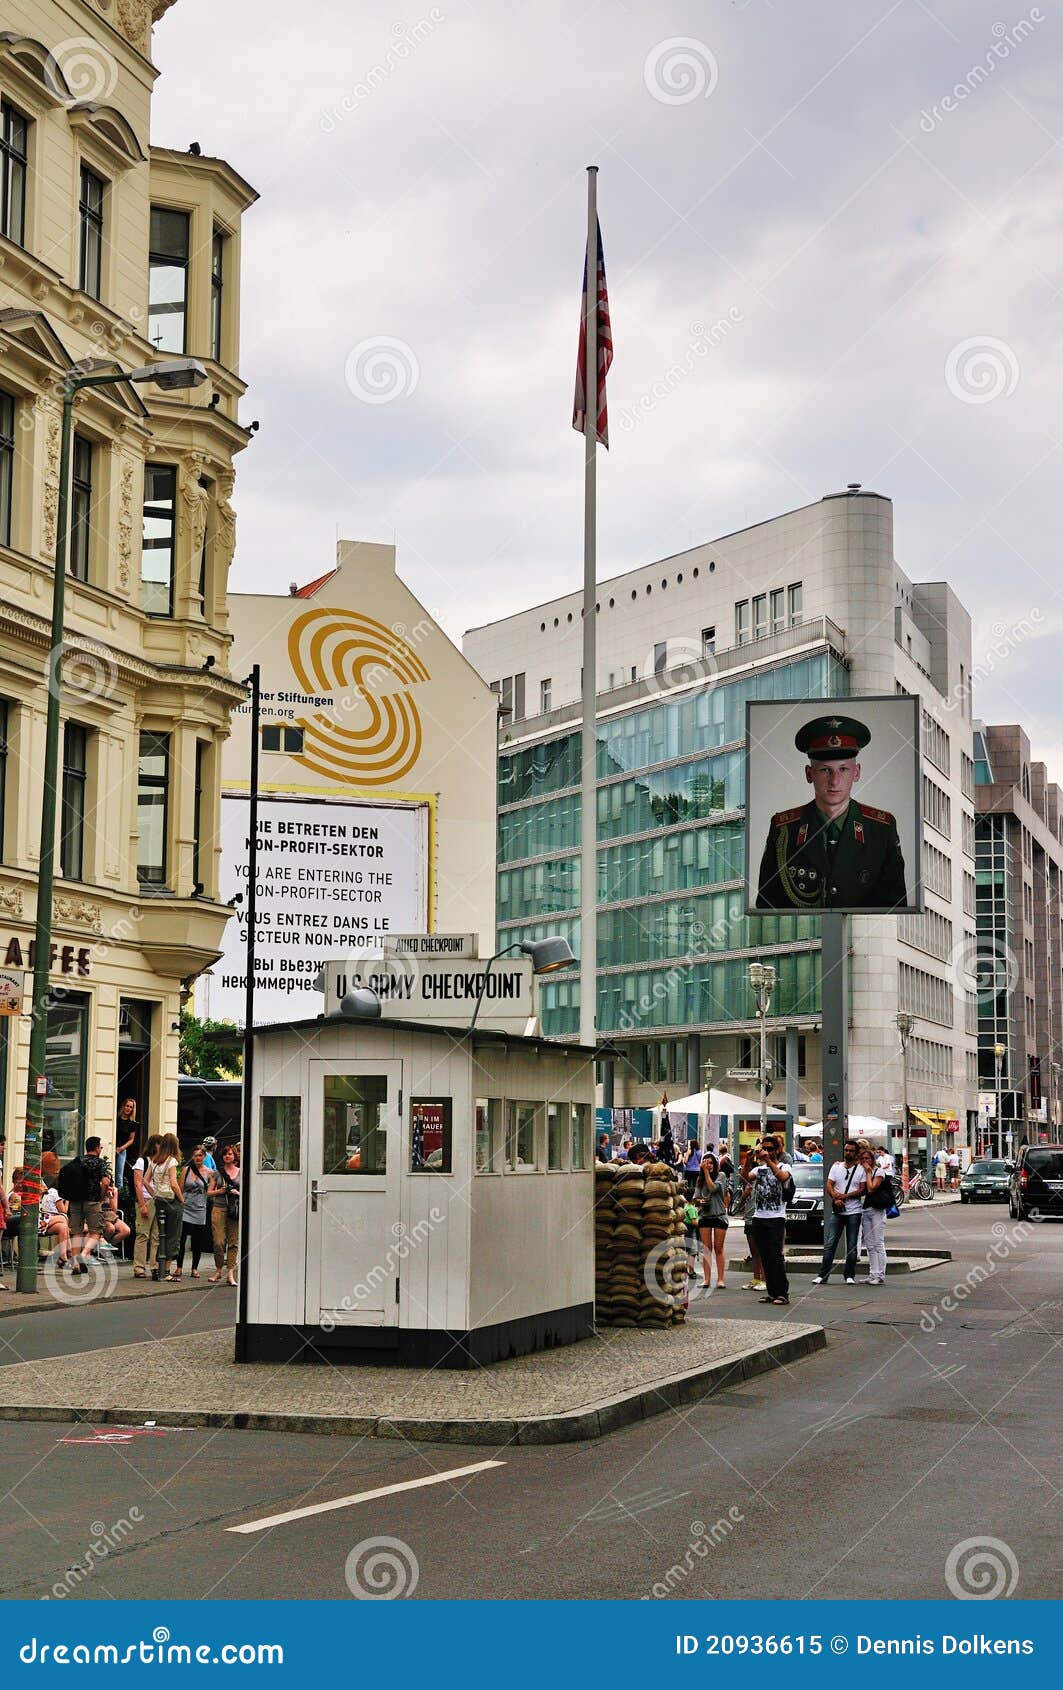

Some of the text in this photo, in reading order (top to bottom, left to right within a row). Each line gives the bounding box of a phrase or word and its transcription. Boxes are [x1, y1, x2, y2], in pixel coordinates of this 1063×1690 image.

[277, 692, 334, 707] Stiftungen
[278, 822, 347, 838] BETRETEN
[352, 827, 379, 840] DEN
[245, 838, 384, 858] NON-PROFIT-SEKTOR
[234, 865, 393, 885] YOU ARE ENTERING THE
[236, 911, 389, 930] VOUS ENTREZ DANS LE
[240, 930, 384, 948] SCTEUR NON-PROFIT
[396, 938, 464, 953] ALLIED CHECKPOINT
[368, 974, 415, 999] ARMY
[422, 973, 523, 999] CHECKPOINT
